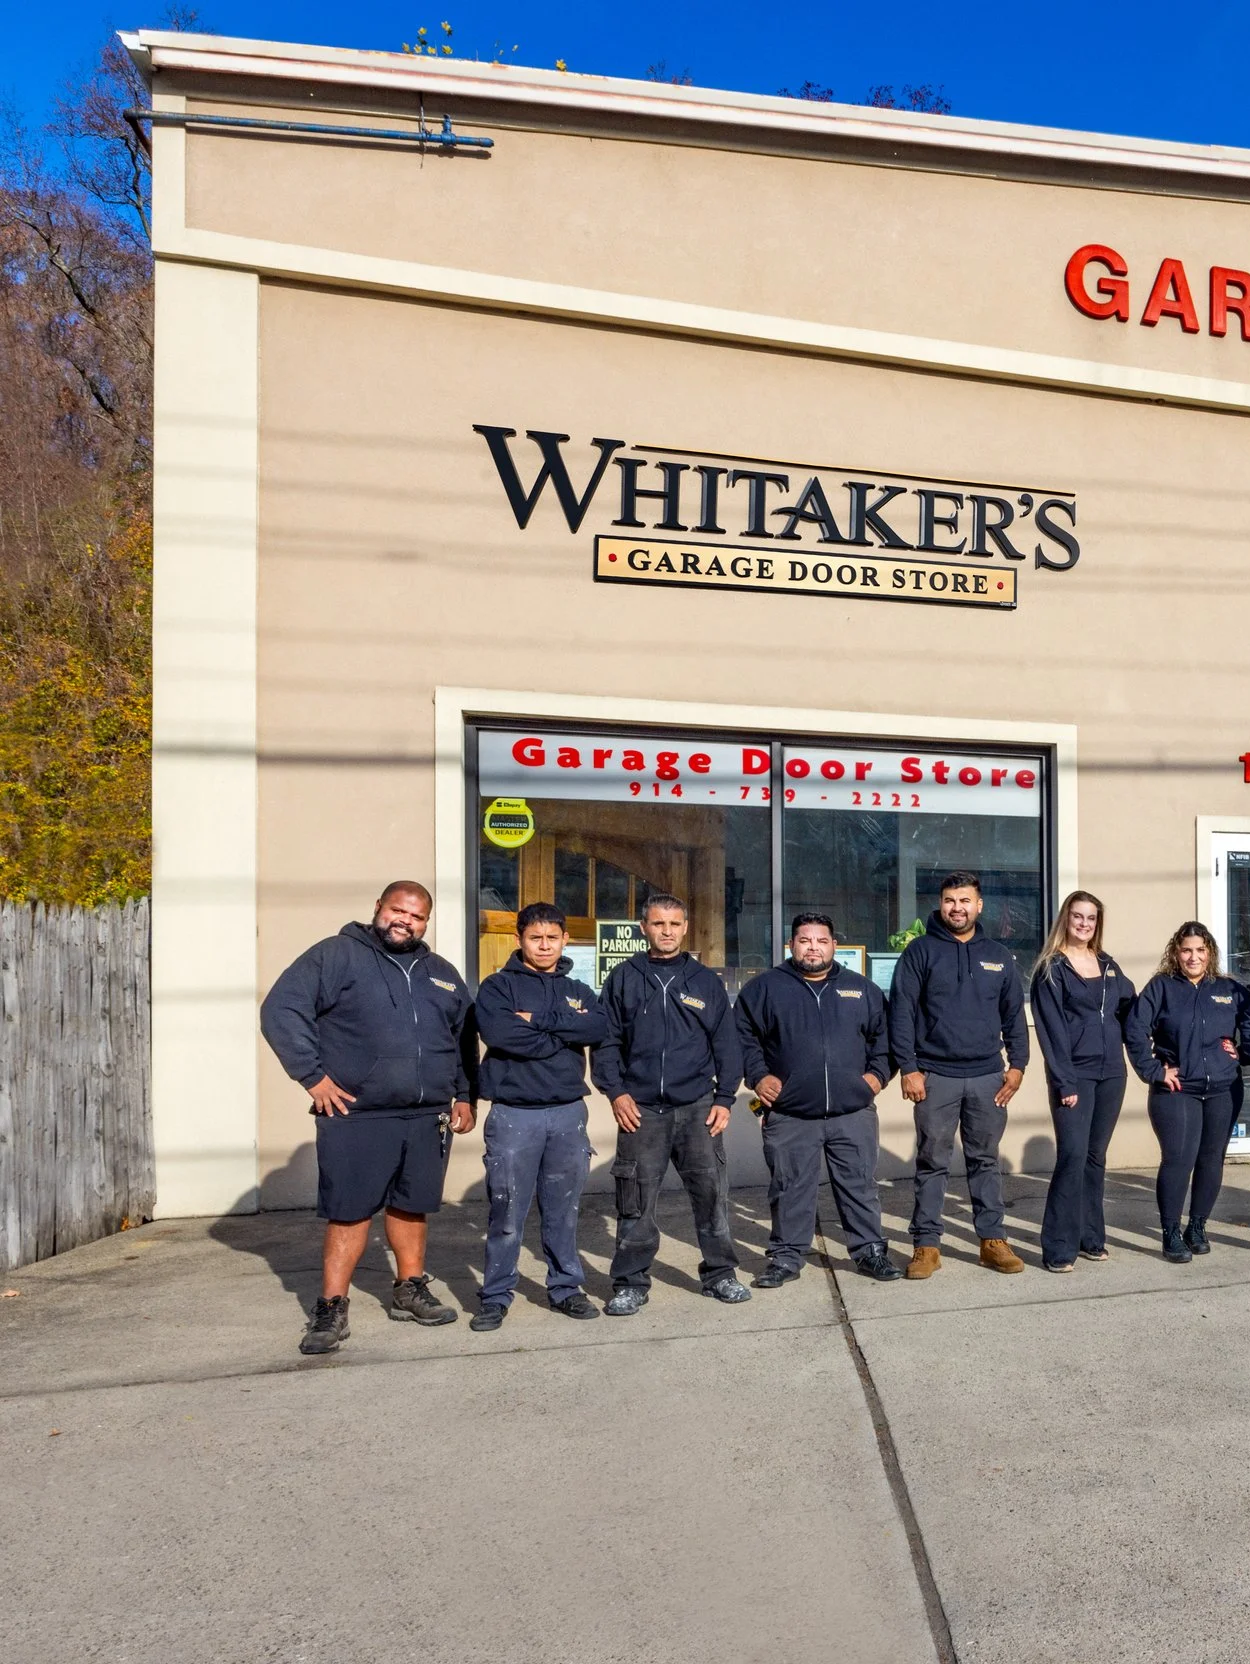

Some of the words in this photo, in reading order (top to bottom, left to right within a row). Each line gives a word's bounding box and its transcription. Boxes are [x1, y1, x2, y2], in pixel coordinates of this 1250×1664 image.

[472, 424, 1081, 571] WHITAKER'S
[627, 548, 775, 580] GARAGE
[788, 560, 880, 588] DOOR
[892, 568, 989, 595] STORE
[512, 737, 712, 781] Garage
[742, 748, 873, 782] Door
[900, 757, 1036, 789] Store
[602, 939, 647, 952] PARKING
[616, 925, 632, 939] NO
